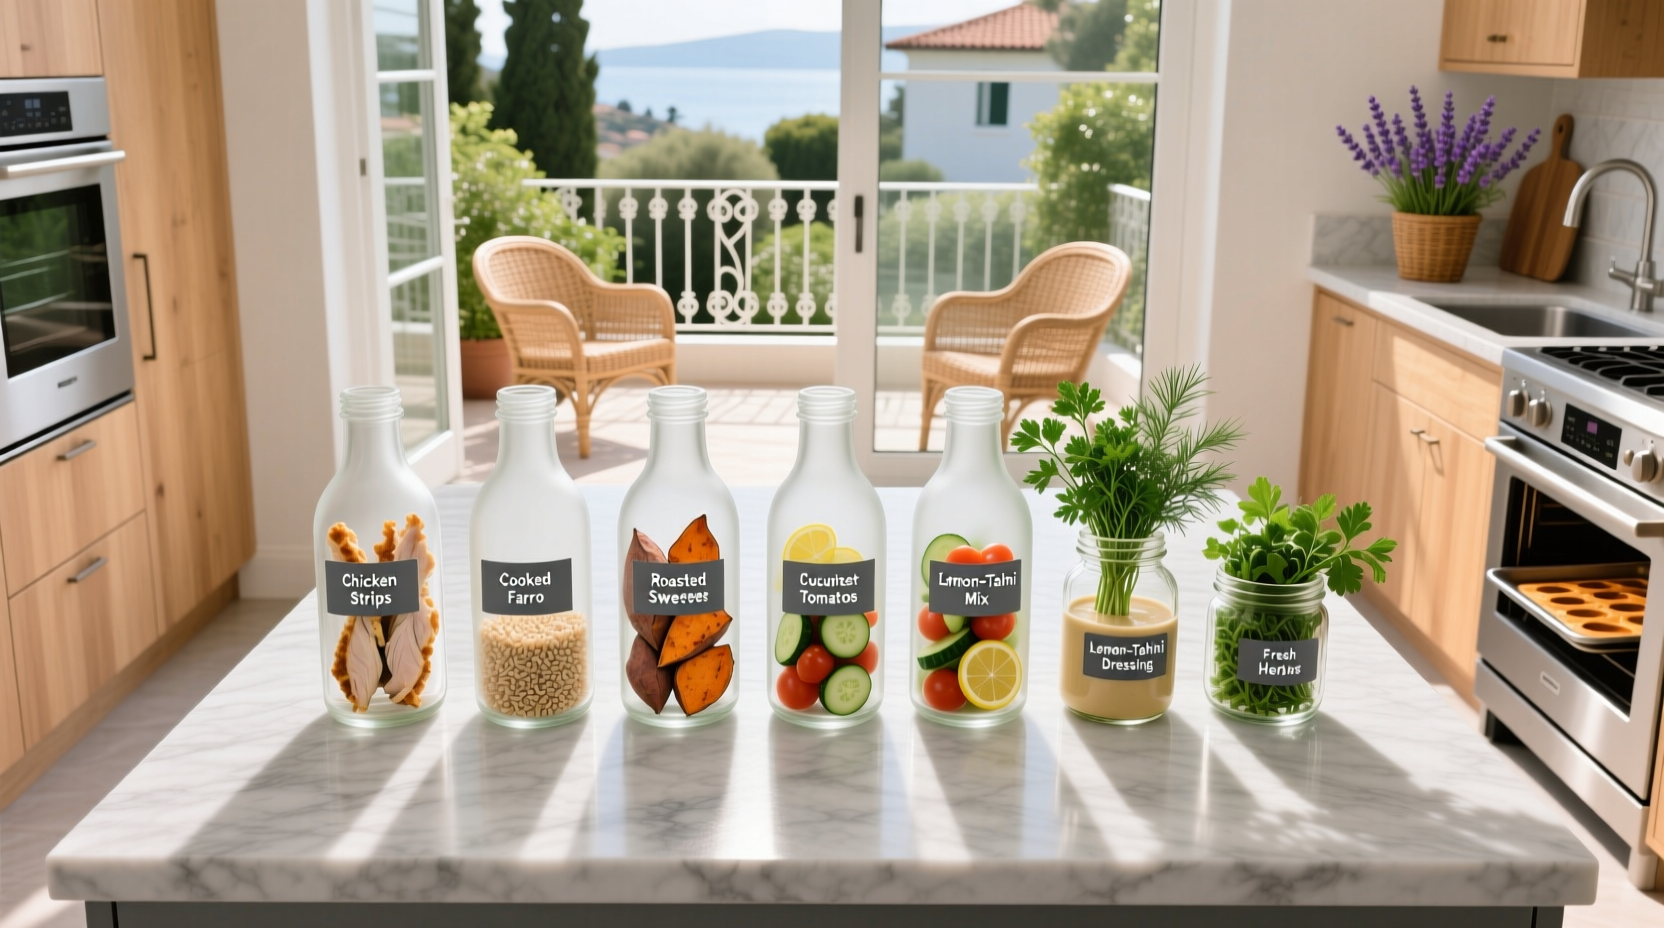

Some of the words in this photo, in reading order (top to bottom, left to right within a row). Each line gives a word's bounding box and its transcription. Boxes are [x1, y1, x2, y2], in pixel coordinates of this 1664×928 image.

[343, 573, 397, 588] Chicken
[498, 572, 551, 587] Cooked
[651, 572, 707, 588] Roasted
[351, 591, 392, 609] Strips
[507, 590, 545, 605] Farro
[799, 590, 858, 605] Tomatos
[964, 591, 989, 606] Mix
[1101, 656, 1154, 673] Dressing
